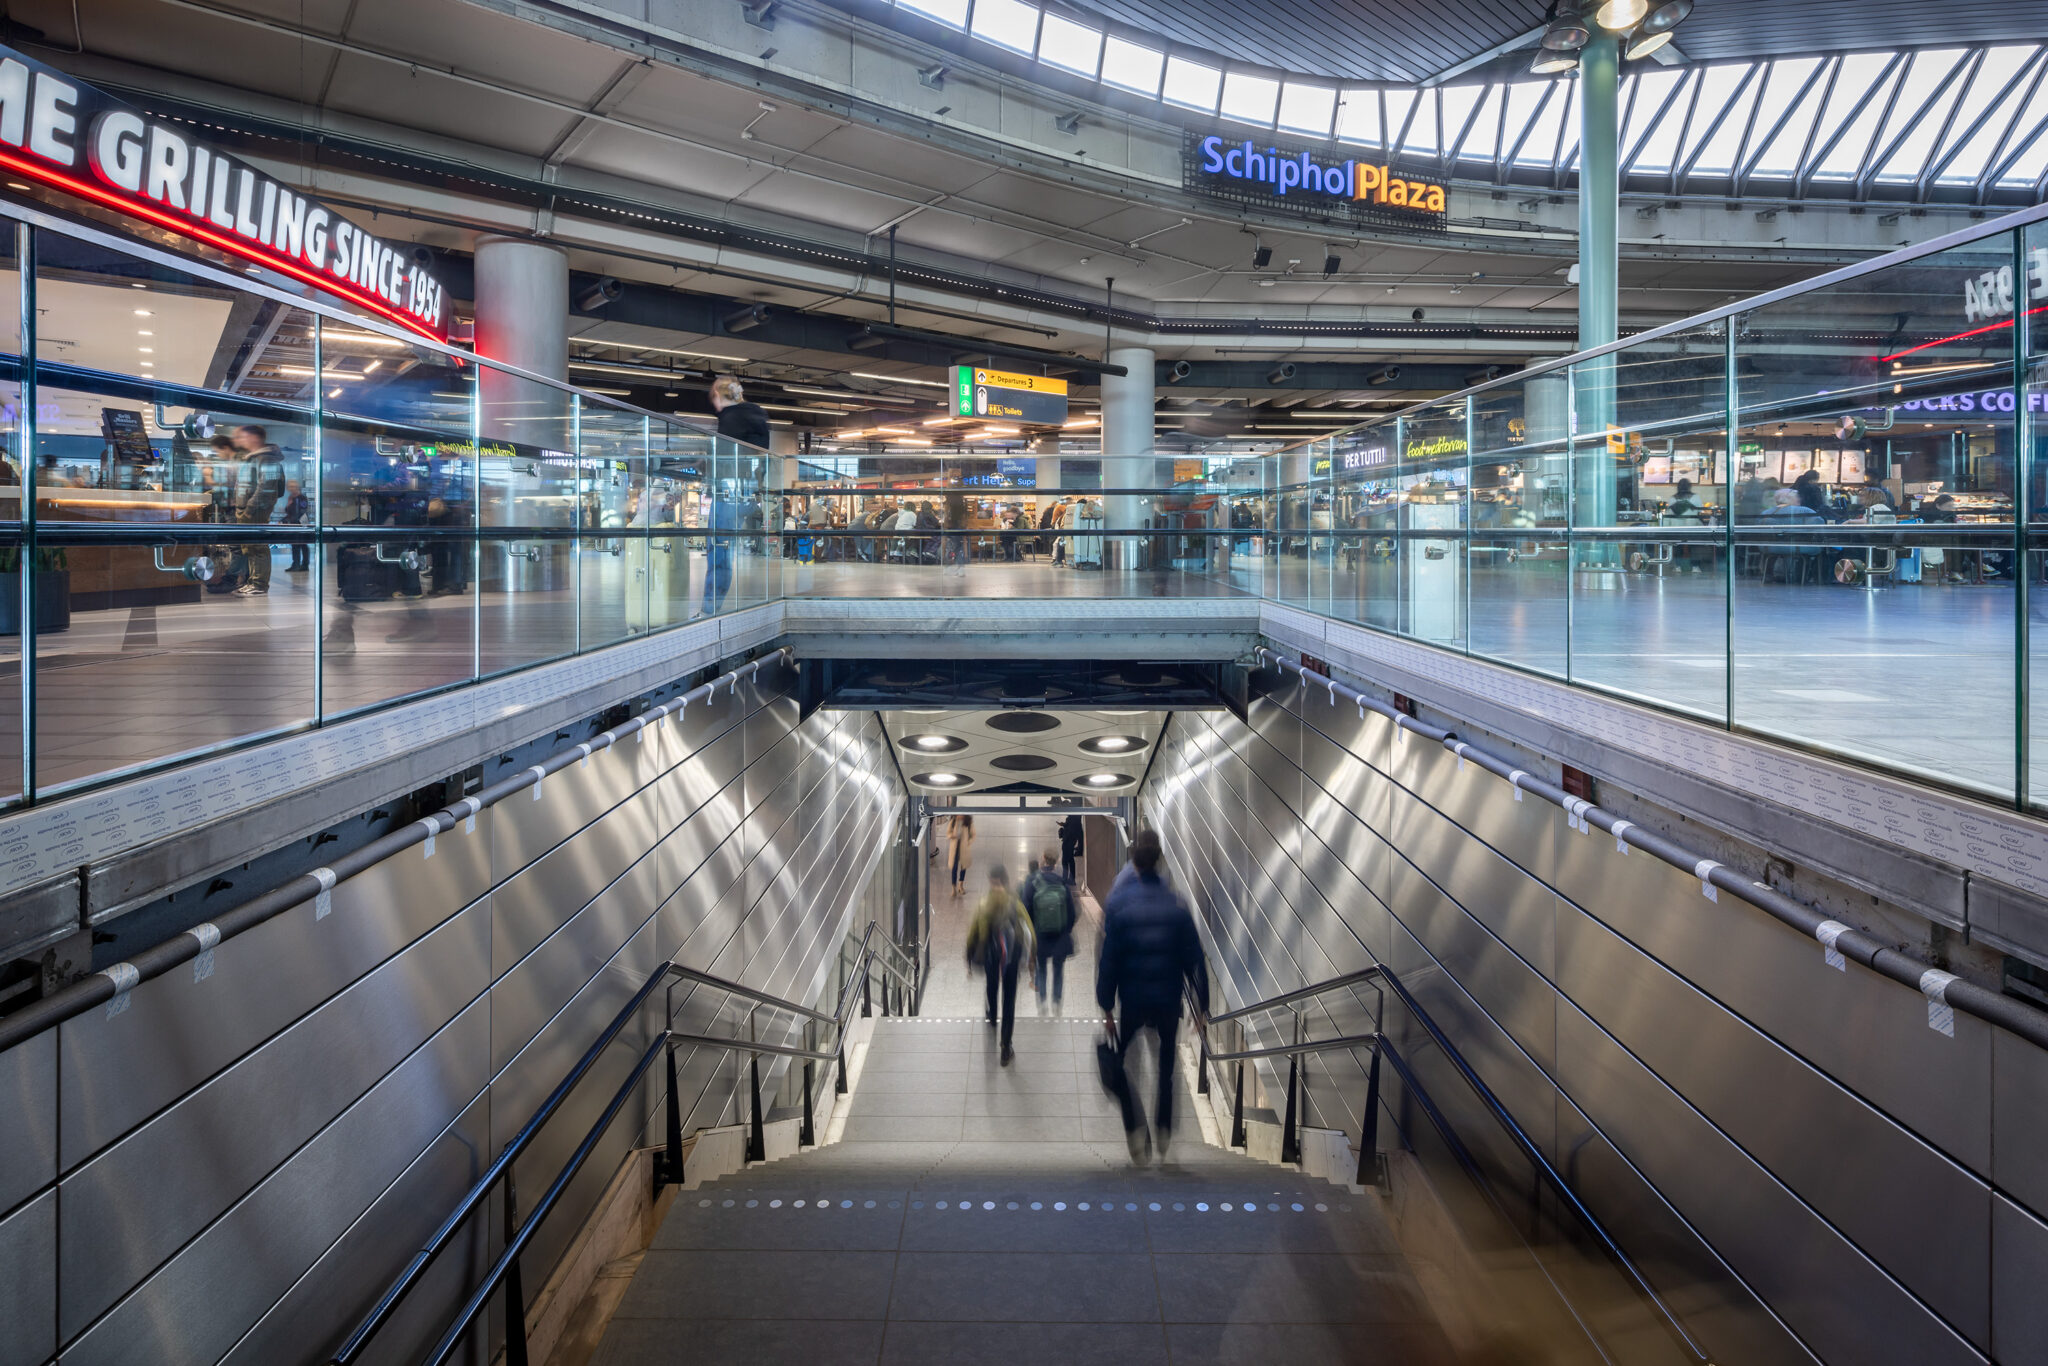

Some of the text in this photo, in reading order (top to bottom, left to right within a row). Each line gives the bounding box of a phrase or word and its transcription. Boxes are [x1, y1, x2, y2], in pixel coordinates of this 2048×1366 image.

[96, 111, 329, 269] GRILLING
[332, 221, 405, 307] SINCE
[408, 265, 442, 329] 1954
[997, 375, 1033, 389] Departures 3
[1003, 406, 1023, 416] Toilets
[1345, 453, 1359, 468] PER
